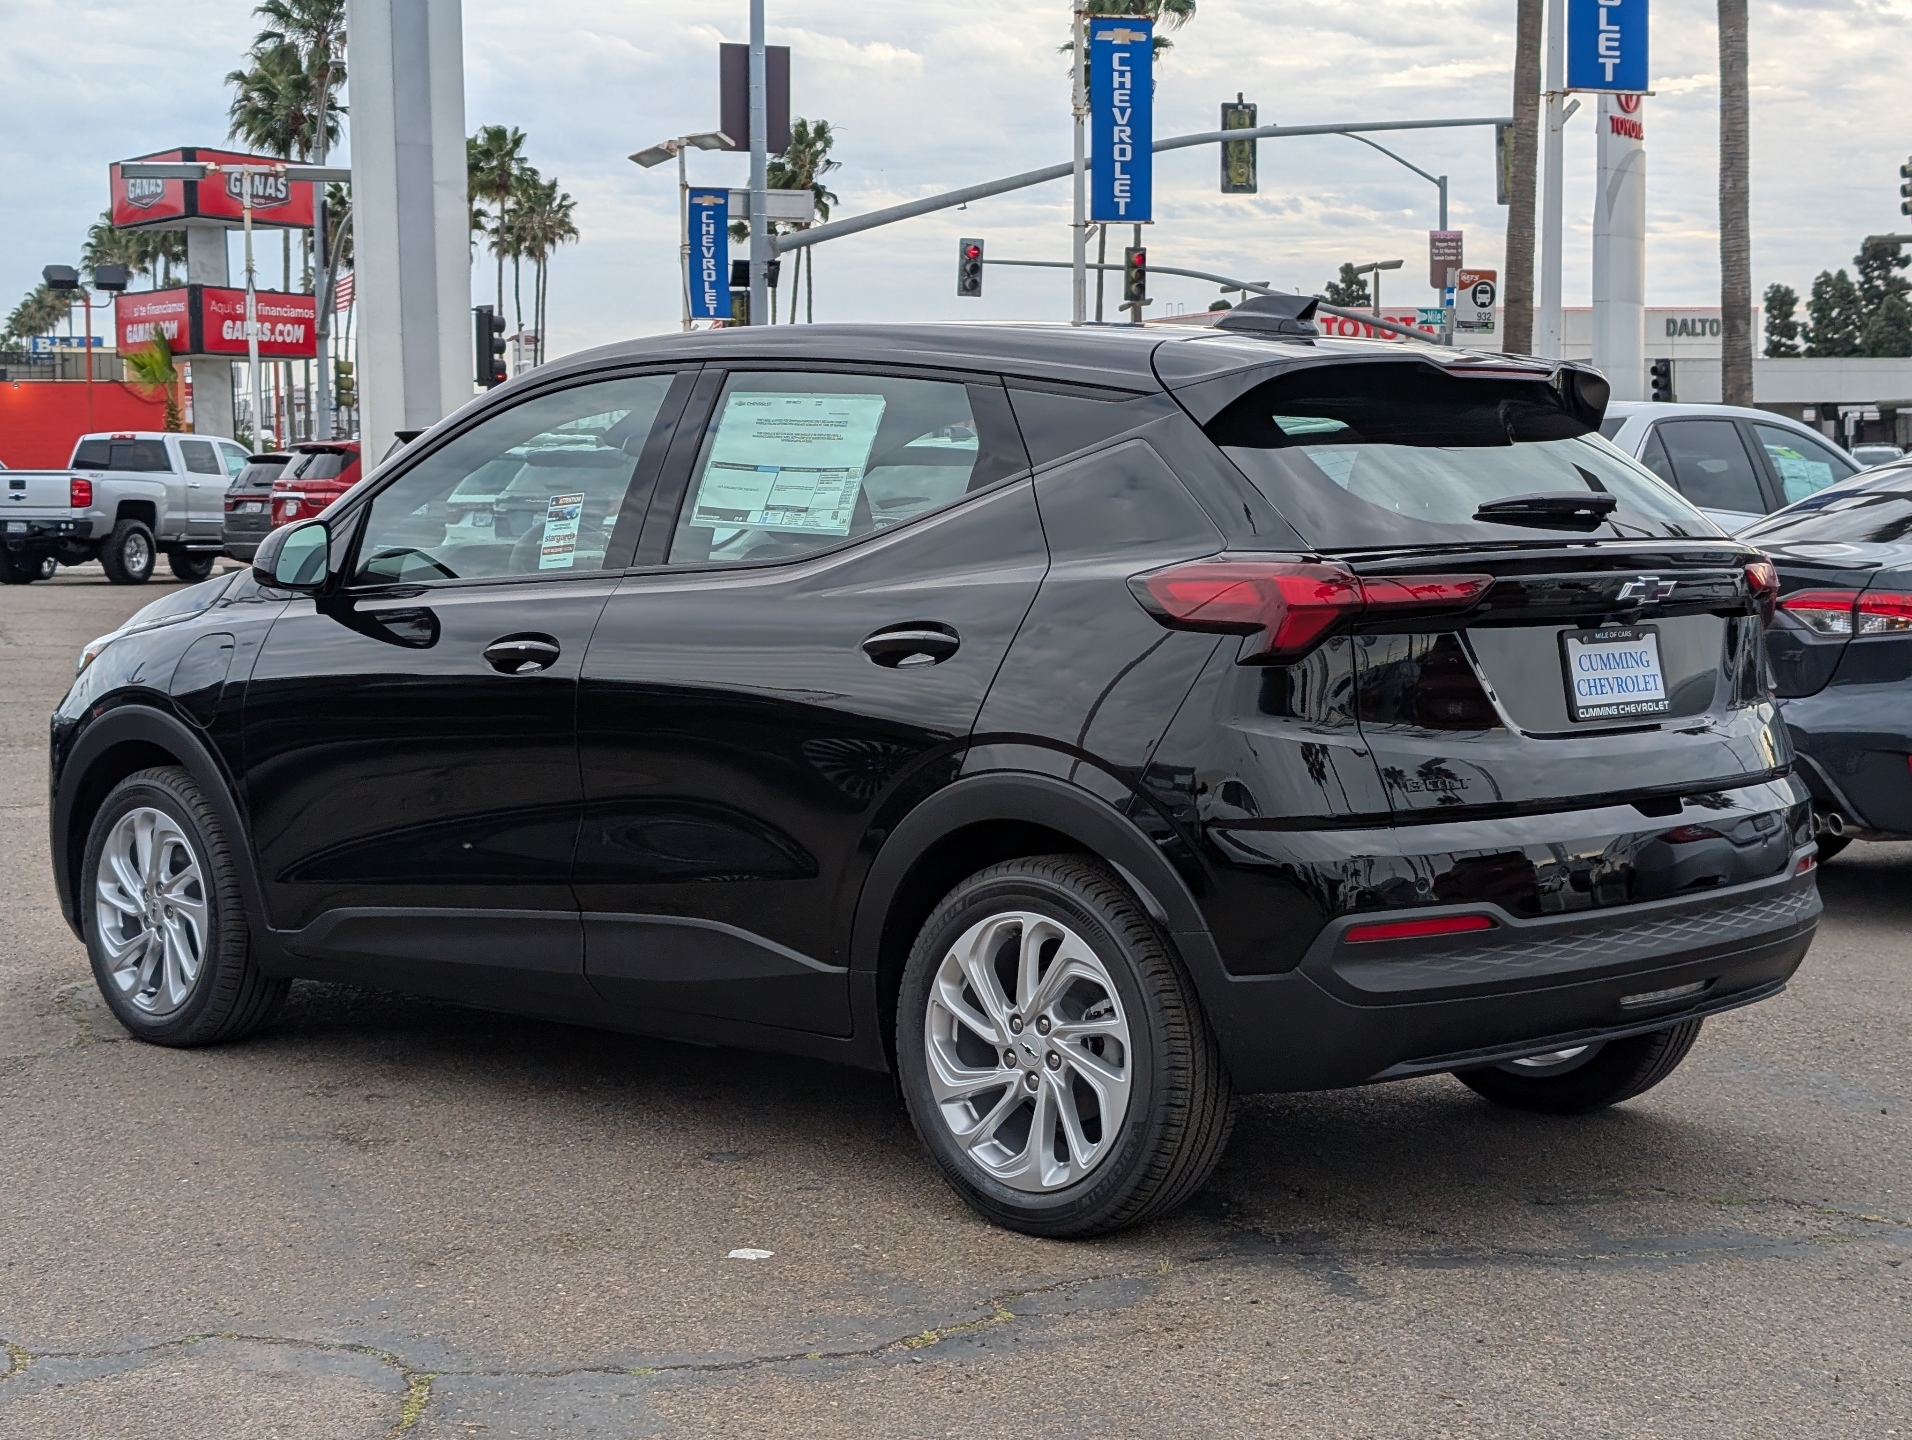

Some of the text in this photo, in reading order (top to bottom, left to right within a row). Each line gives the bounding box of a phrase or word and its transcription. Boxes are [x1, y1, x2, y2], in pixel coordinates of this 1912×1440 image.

[1112, 52, 1133, 215] CHEVROLET
[1609, 115, 1644, 140] TOYOTA
[230, 172, 287, 198] GNAS
[701, 211, 717, 316] CHEVROLET
[147, 301, 185, 315] financiamos
[235, 302, 244, 314] sí
[257, 303, 315, 319] financiamos
[1427, 310, 1441, 323] Mile
[1477, 312, 1491, 321] 932
[126, 320, 178, 343] GANASOM
[1578, 650, 1650, 672] CUMMING
[1577, 674, 1659, 697] CHEVROLET
[1579, 701, 1669, 718] CUMMING CHEVROLET
